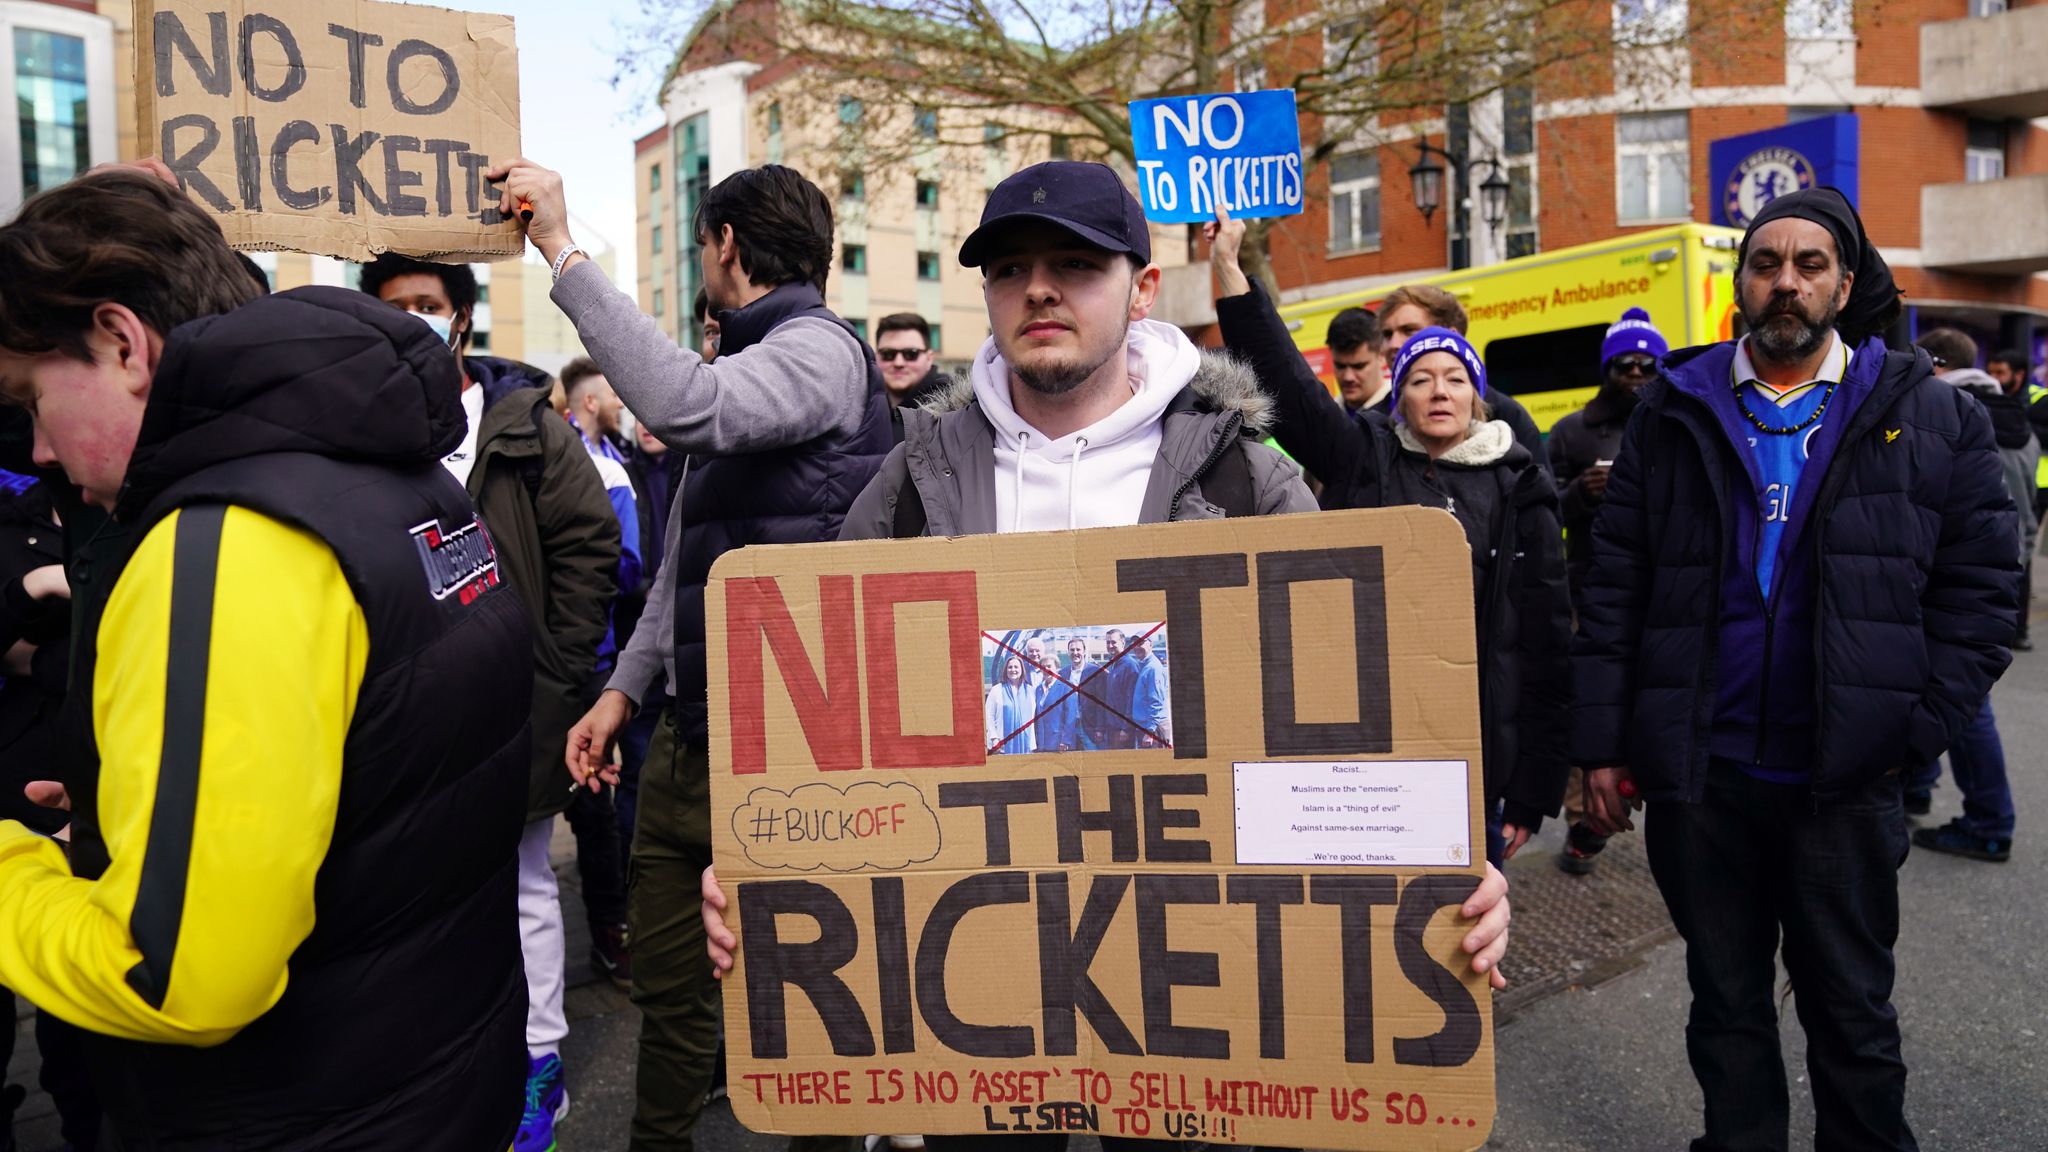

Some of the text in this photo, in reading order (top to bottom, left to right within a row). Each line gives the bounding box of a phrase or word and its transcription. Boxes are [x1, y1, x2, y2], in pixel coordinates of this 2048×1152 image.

[153, 11, 460, 115] NO TO
[1153, 97, 1244, 150] NO
[161, 114, 506, 225] RICKETTS
[1188, 153, 1301, 213] RICKETTS
[1740, 147, 1798, 175] CHELSEA
[1465, 276, 1650, 322] mergency Ambulance
[725, 545, 1393, 774] NO TO
[1291, 784, 1325, 793] Muslims
[1343, 784, 1357, 793] the
[1302, 804, 1325, 813] Islam
[1327, 804, 1334, 813] is
[1371, 804, 1379, 813] of
[748, 803, 906, 843] #BUCKOFF
[938, 773, 1212, 866] THE
[1291, 824, 1323, 834] Against
[1340, 853, 1364, 862] good,
[1366, 852, 1397, 861] thanks.
[738, 871, 1484, 1067] RICKETTS
[743, 1070, 852, 1104] THERE
[866, 1069, 904, 1104] IS
[914, 1070, 959, 1104] NO
[1071, 1068, 1112, 1104] TO
[1129, 1071, 1197, 1111] SELL
[1204, 1077, 1319, 1121] WITHOUT
[1331, 1087, 1370, 1123] US
[984, 1102, 1099, 1132] LISTEN
[1112, 1108, 1150, 1137] TO
